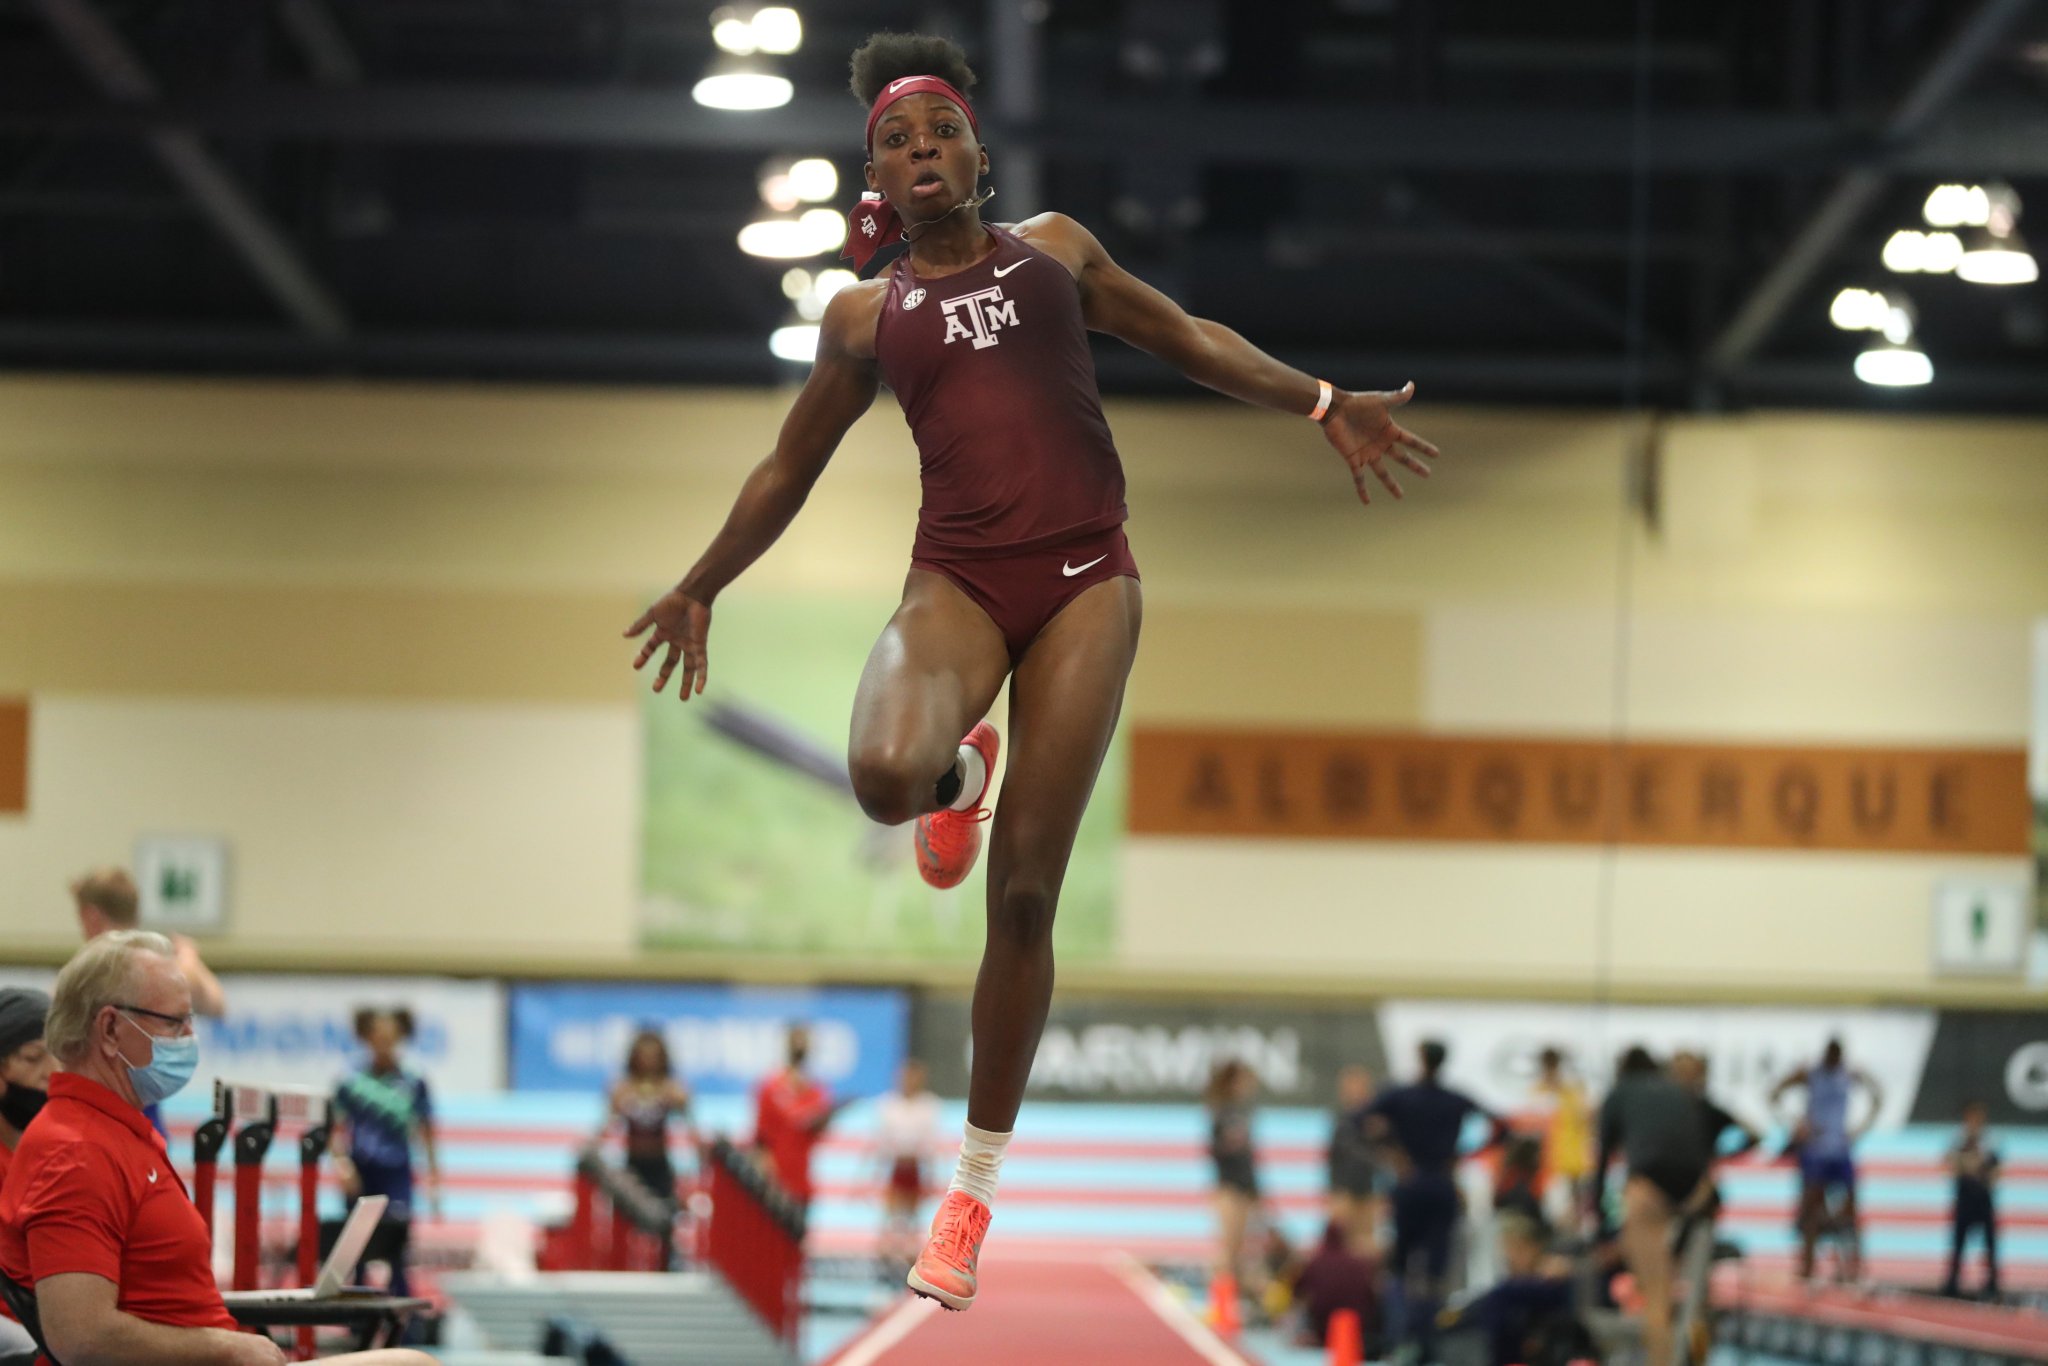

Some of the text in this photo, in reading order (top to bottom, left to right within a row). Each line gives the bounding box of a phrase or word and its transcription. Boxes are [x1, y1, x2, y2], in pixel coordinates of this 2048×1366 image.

[903, 288, 926, 310] SEC
[1181, 751, 1968, 838] ALBUQUERQUE
[966, 1023, 1302, 1094] ARMIN
